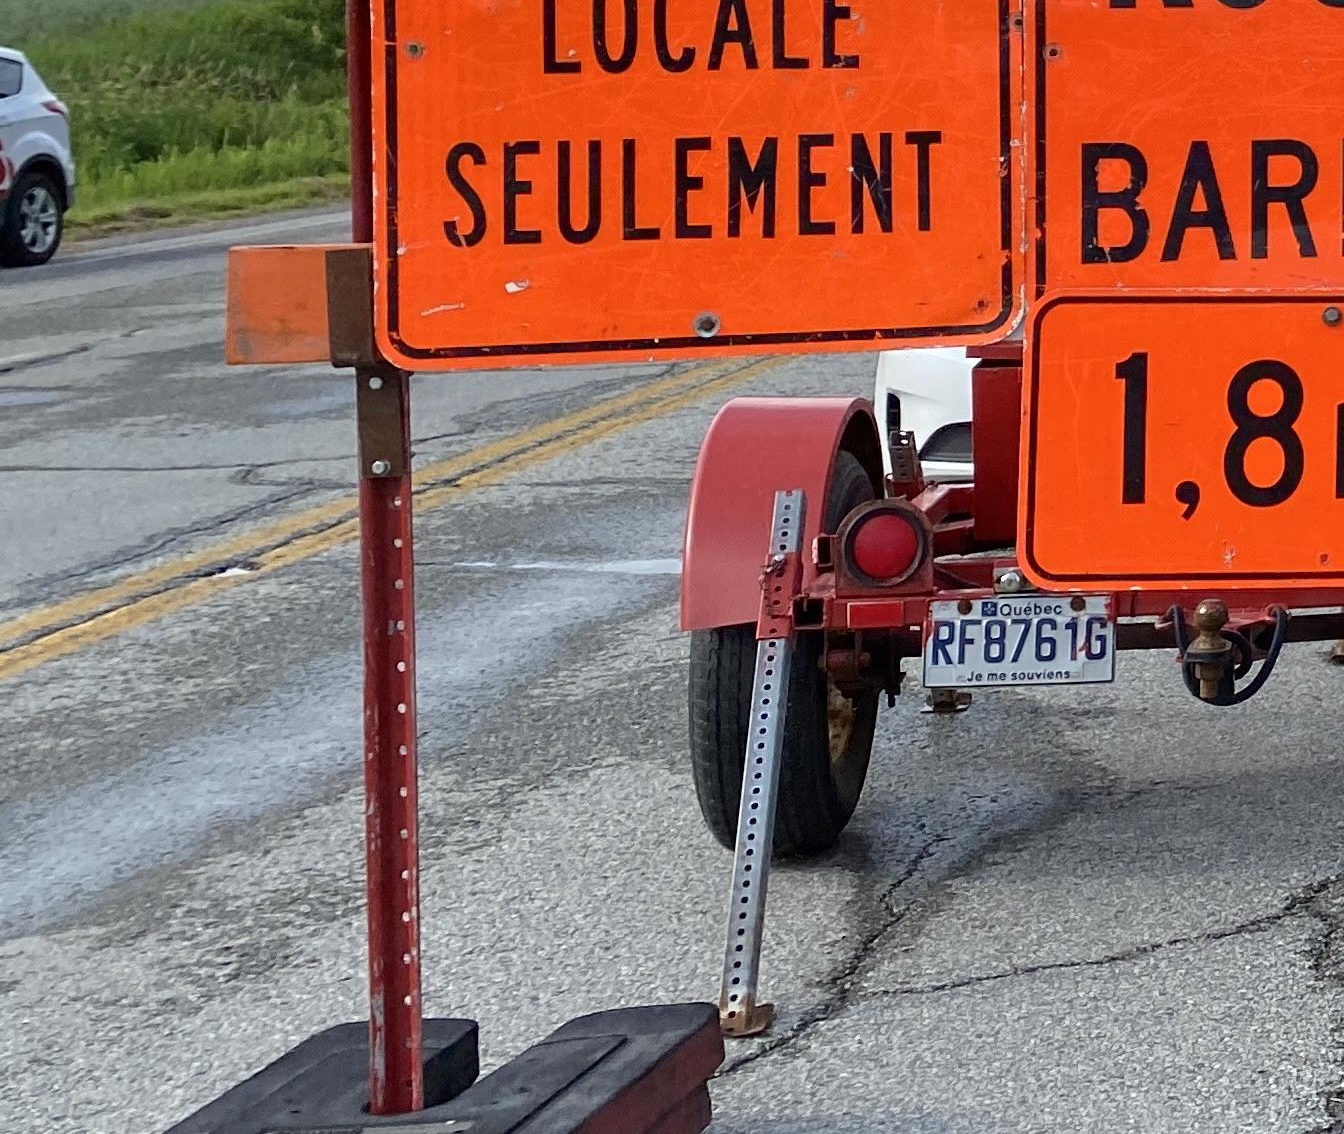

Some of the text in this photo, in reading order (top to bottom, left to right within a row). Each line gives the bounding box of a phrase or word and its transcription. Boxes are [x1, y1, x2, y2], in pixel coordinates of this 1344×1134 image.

[443, 130, 943, 247] SEULEMENT
[1114, 352, 1305, 521] 1,8
[1000, 602, 1062, 617] Québec
[931, 617, 1108, 665] RF8761G
[967, 670, 1070, 682] Je me souviens
